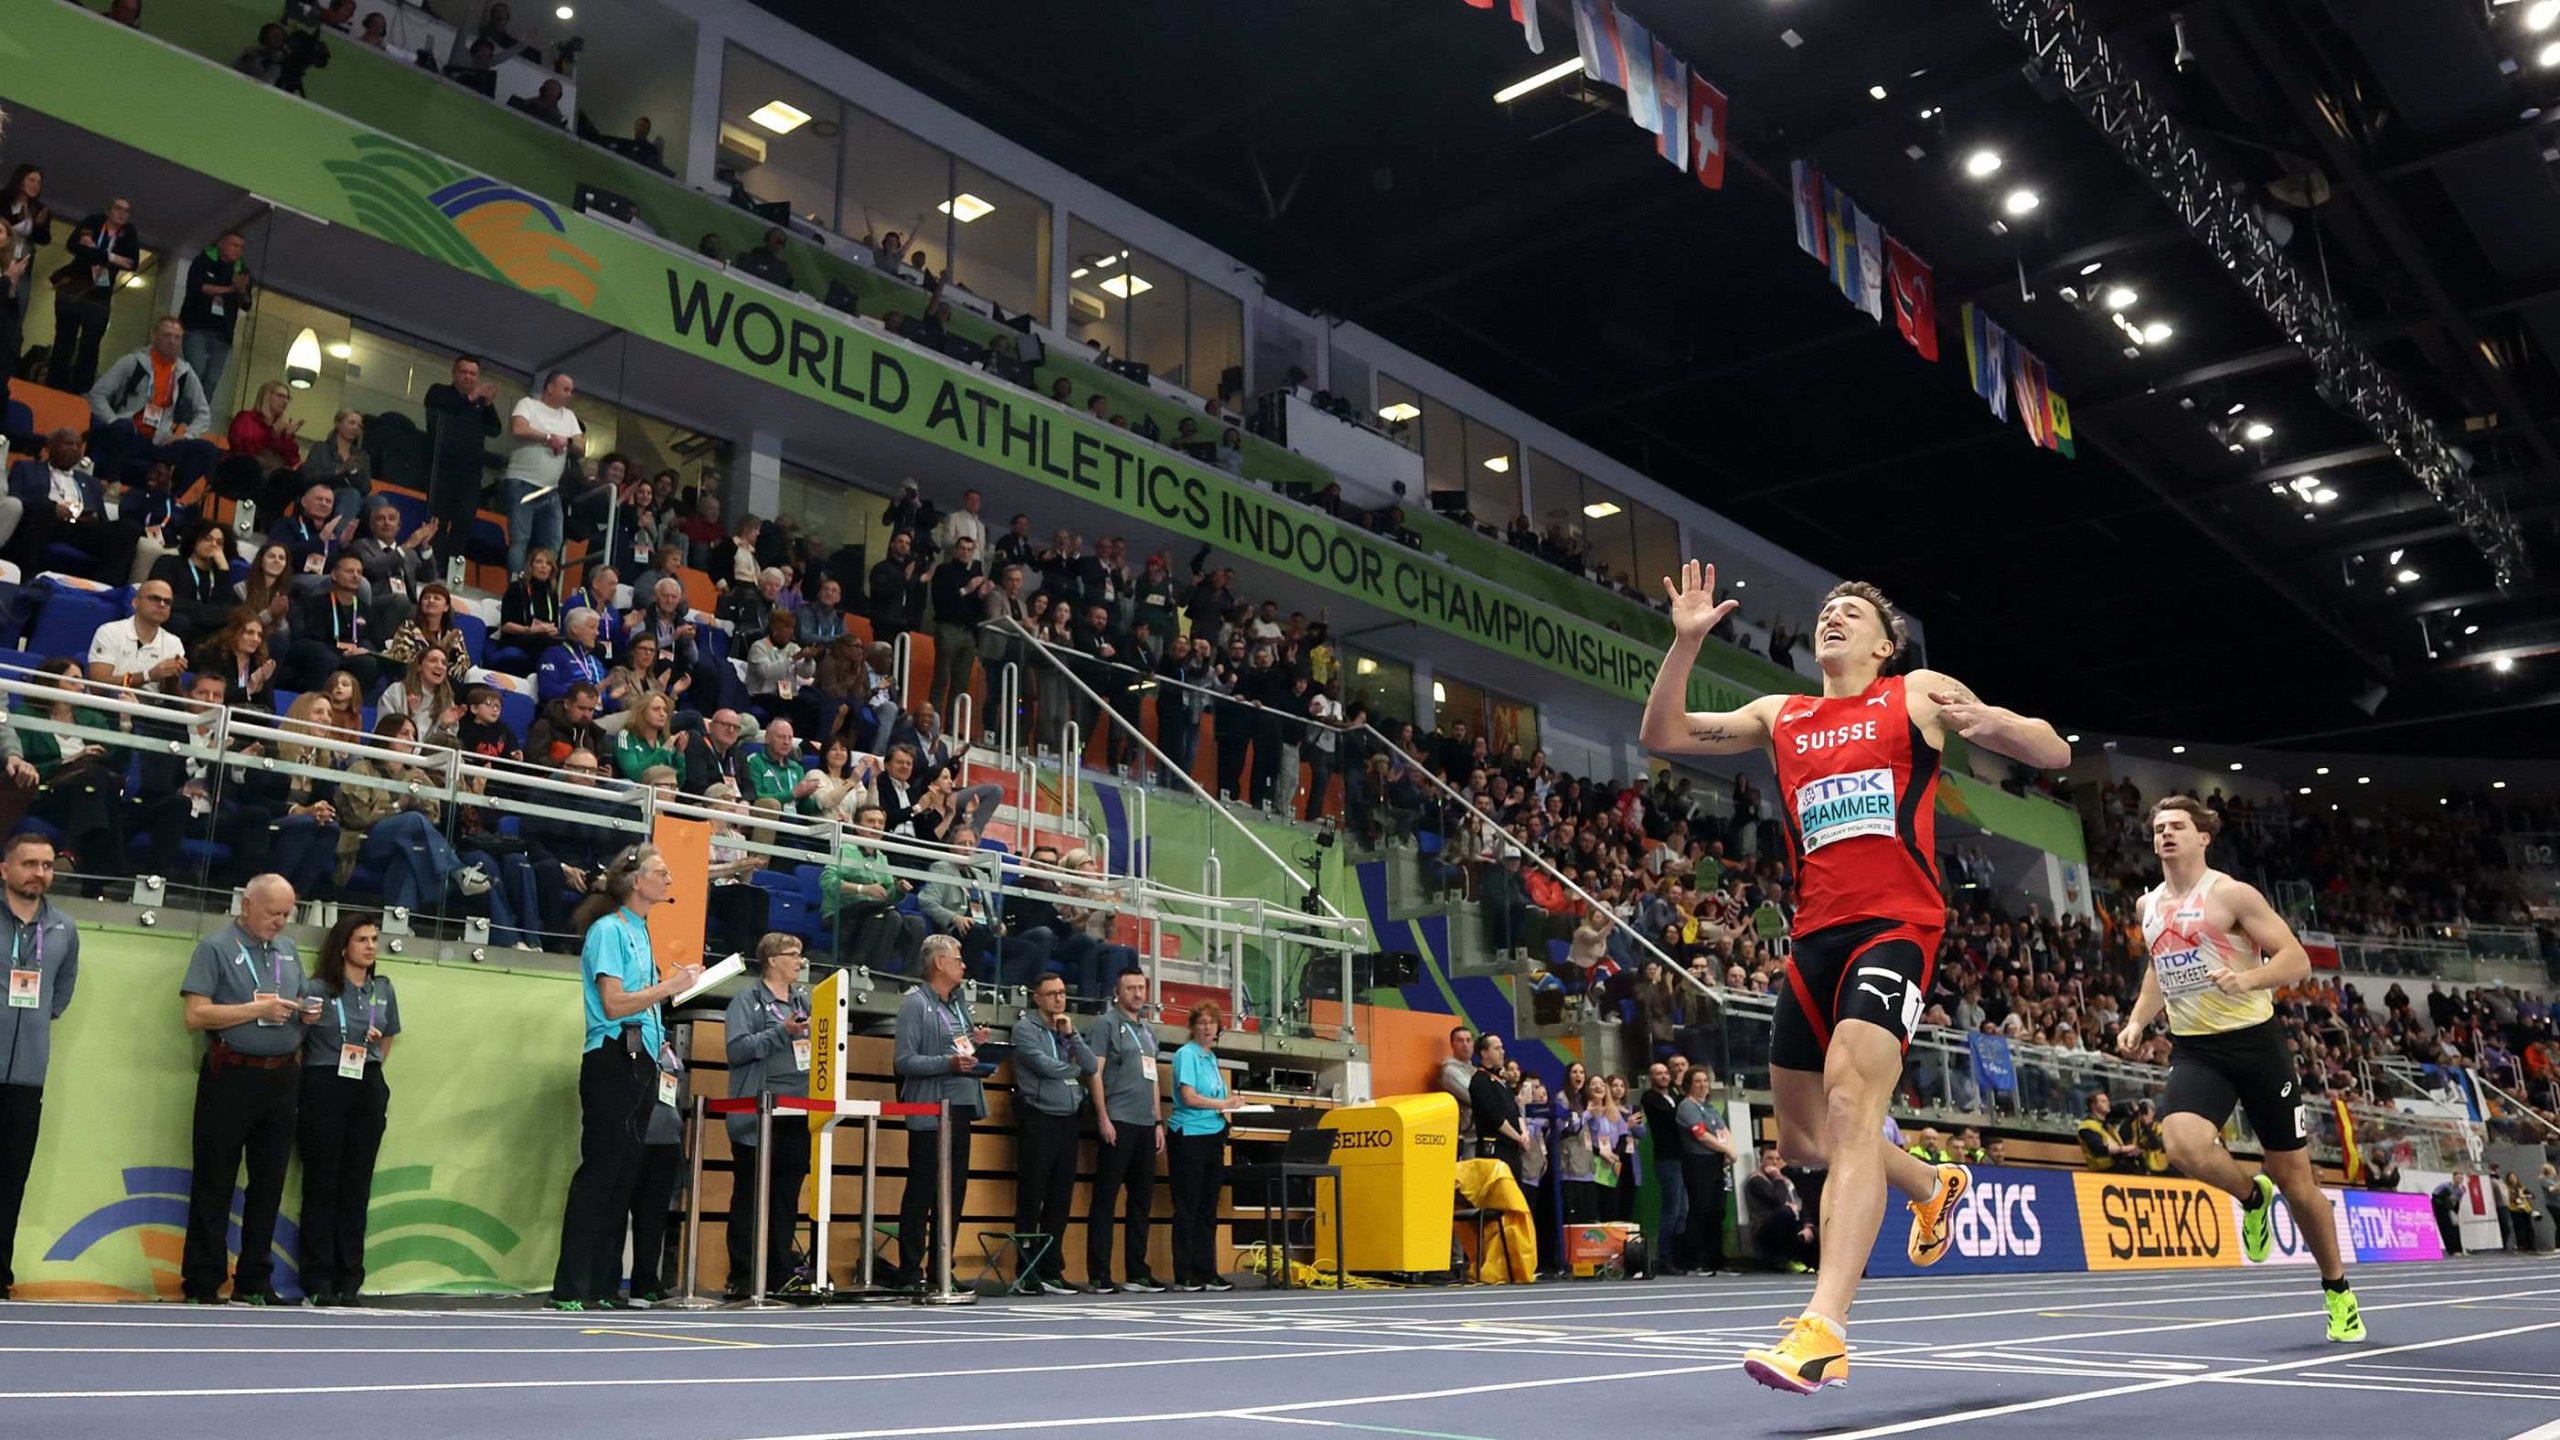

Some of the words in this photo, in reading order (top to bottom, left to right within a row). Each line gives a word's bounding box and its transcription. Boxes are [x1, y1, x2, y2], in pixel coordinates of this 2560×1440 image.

[666, 268, 910, 414] WORLD
[926, 379, 1210, 529] ATHLETICS
[1222, 491, 1384, 597] INDOOR
[1394, 562, 1658, 697] CHAMPIONSHIPS
[1815, 772, 1885, 800] TDK
[1801, 794, 1891, 833] EHAMMER
[2161, 949, 2203, 969] TDK
[817, 1018, 829, 1092] SEIKO
[1332, 1130, 1393, 1150] SEIKO
[1414, 1134, 1447, 1146] SEIKO
[2102, 1184, 2221, 1260] SEIKO
[2357, 1206, 2400, 1249] TDK
